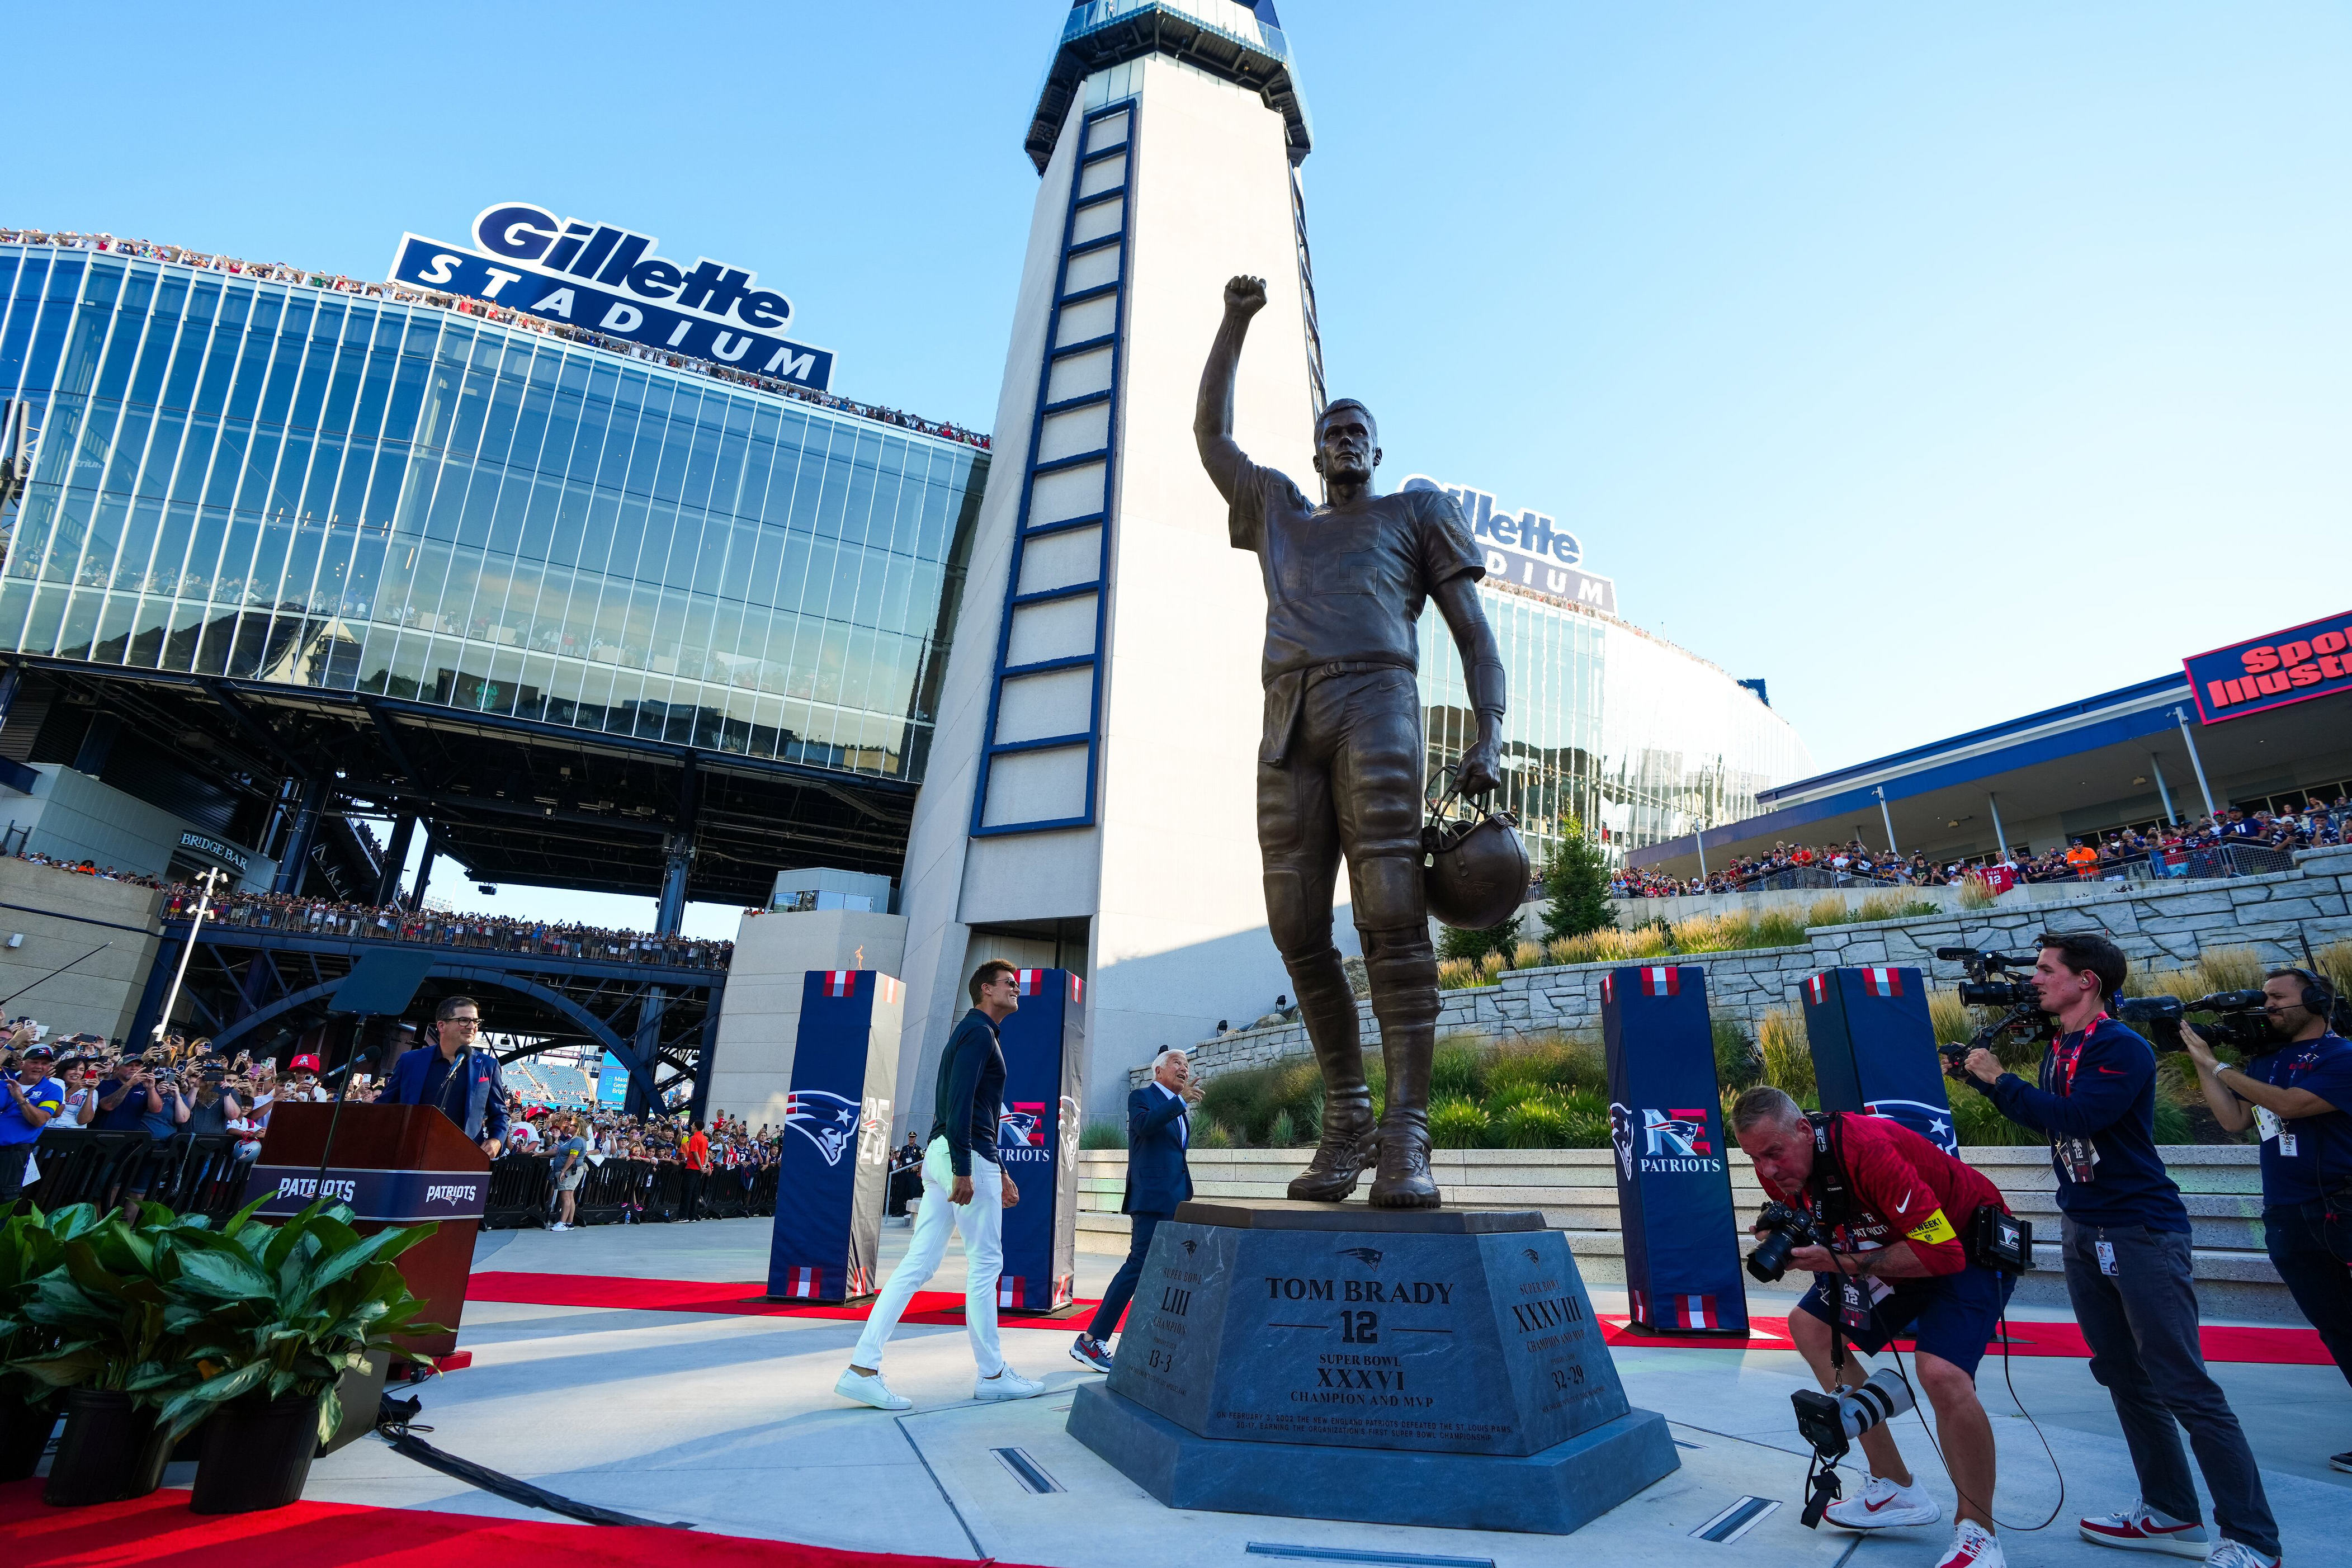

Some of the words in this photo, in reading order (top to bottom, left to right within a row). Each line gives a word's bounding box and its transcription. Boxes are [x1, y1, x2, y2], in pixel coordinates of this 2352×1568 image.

[479, 206, 790, 328] Gillette
[418, 254, 816, 381] STADIUM
[1404, 478, 1579, 564] llette
[1487, 550, 1603, 606] DIUM
[181, 833, 224, 856] BRIDGE
[224, 848, 247, 871] BAR
[1989, 875, 2001, 885] 12
[998, 1149, 1050, 1162] TRIOTS
[2074, 1148, 2084, 1159] 12
[1640, 1159, 1721, 1172] PATRIOTS
[277, 1178, 356, 1202] PATRIOTS
[426, 1186, 476, 1205] PATRIOTS
[1163, 1267, 1182, 1282] SUPER
[1183, 1271, 1202, 1285] BOWL
[1519, 1282, 1542, 1295] SUPER
[1542, 1279, 1561, 1292] BOWL
[1161, 1287, 1192, 1316] LIII
[1265, 1277, 1335, 1301] TOM
[1344, 1280, 1454, 1305] BRADY
[1845, 1292, 1858, 1305] 12
[1153, 1316, 1187, 1336] CHAMPION
[1340, 1310, 1378, 1343] 12
[1512, 1296, 1583, 1334] XXXVIII
[1527, 1334, 1560, 1353] CHAMPION
[1560, 1331, 1572, 1343] AND
[1572, 1329, 1585, 1340] MVP
[1149, 1349, 1172, 1373] 13-3
[1319, 1354, 1361, 1366] SUPER
[1363, 1356, 1401, 1367] BOWL
[1316, 1368, 1405, 1391] XXXVI
[1552, 1364, 1584, 1392] 32-29
[1291, 1391, 1365, 1405] CHAMPION
[1370, 1395, 1399, 1407] AND
[1404, 1397, 1433, 1408] MVP
[1229, 1412, 1263, 1421] FEBRUARY
[1331, 1418, 1362, 1427] ENGLAND
[1401, 1421, 1437, 1430] DEFEATED
[1260, 1423, 1289, 1432] EARNING
[1309, 1426, 1365, 1435] ORGANIZATION'S
[1368, 1428, 1387, 1437] FIRST
